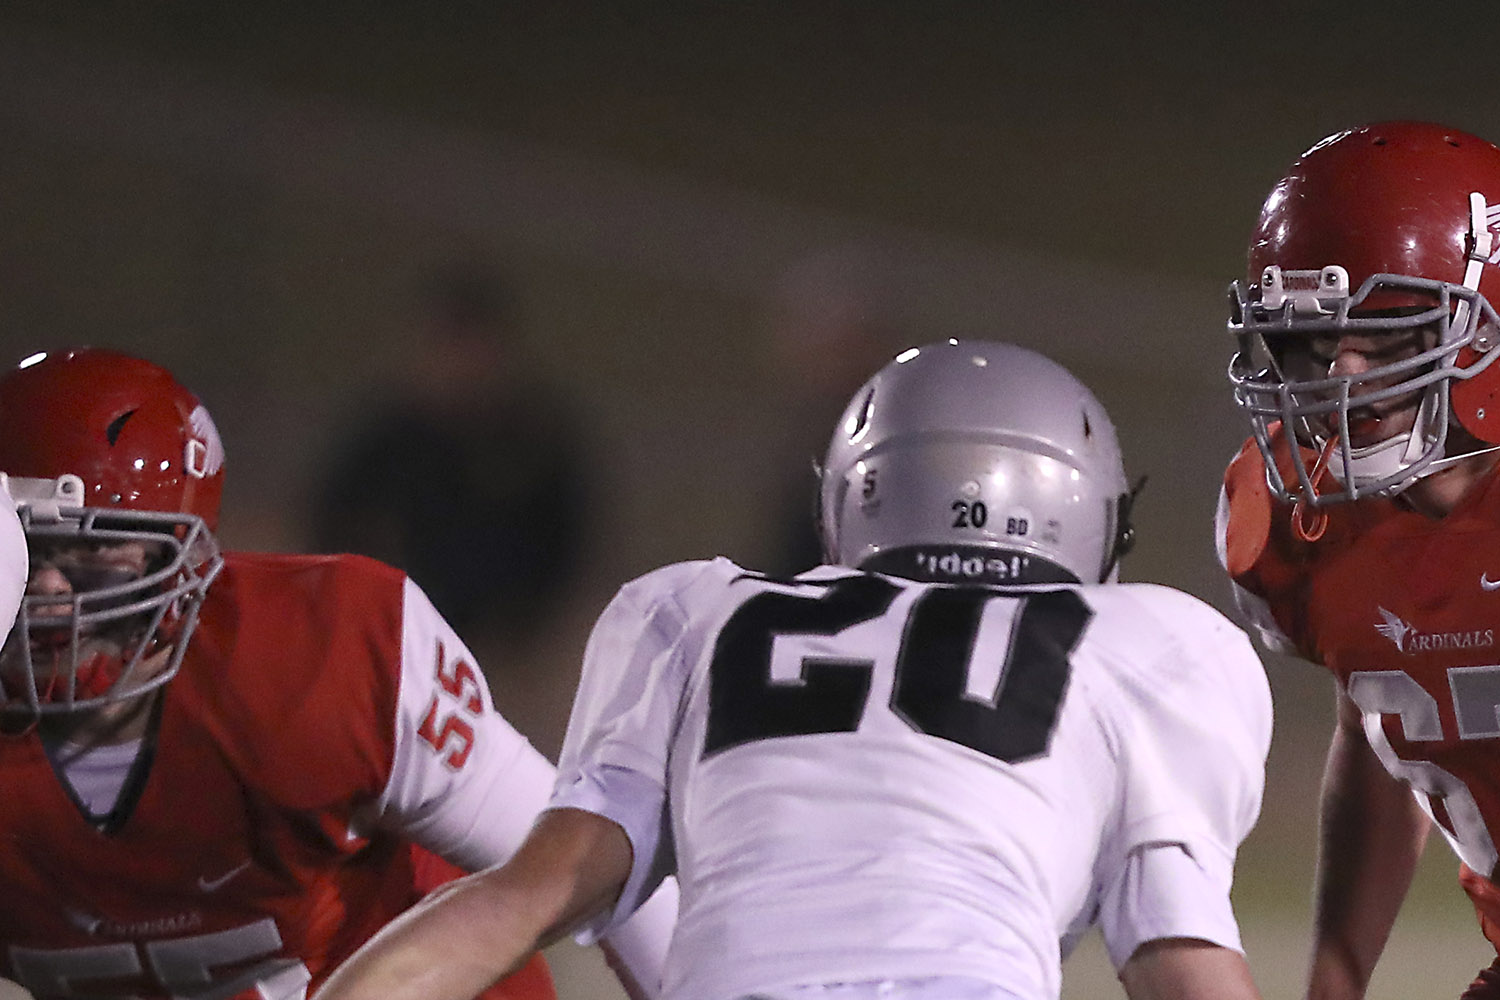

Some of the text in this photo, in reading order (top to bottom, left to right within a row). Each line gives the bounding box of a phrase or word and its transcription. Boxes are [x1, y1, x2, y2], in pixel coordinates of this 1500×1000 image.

[951, 501, 987, 529] 20
[416, 636, 484, 773] 55
[701, 573, 1096, 765] 20
